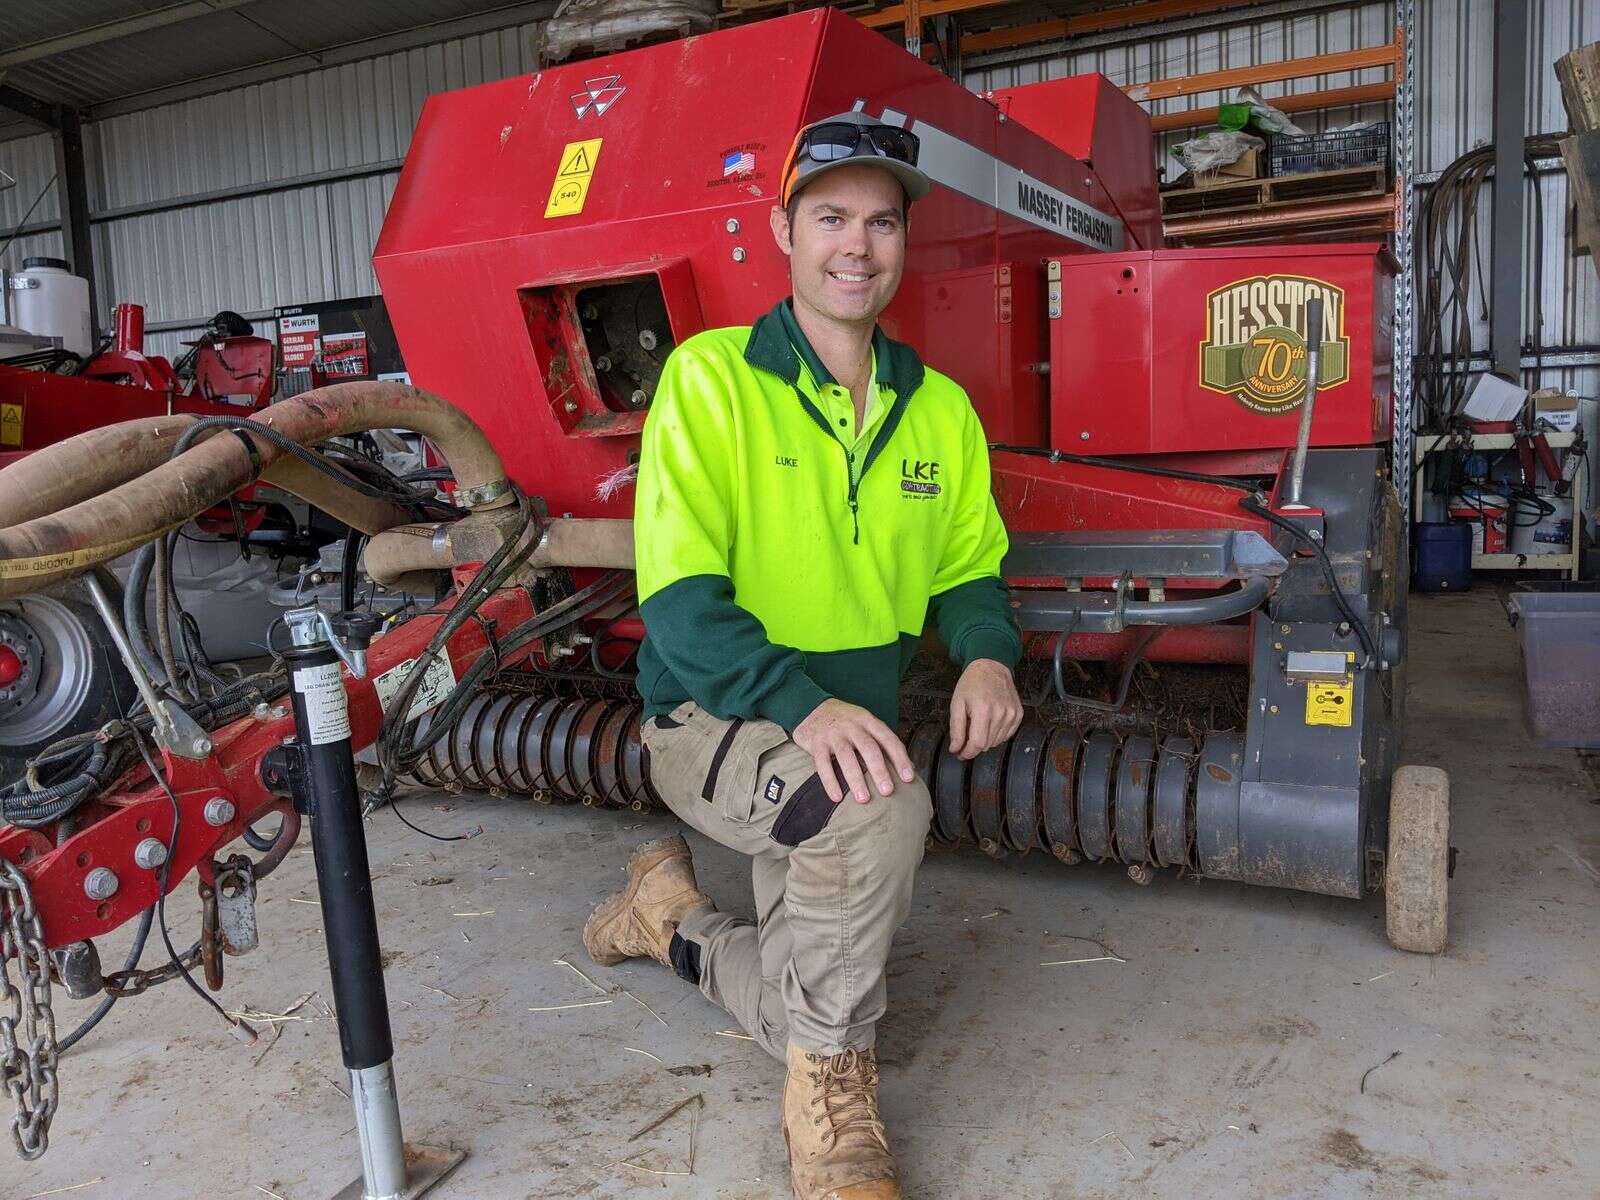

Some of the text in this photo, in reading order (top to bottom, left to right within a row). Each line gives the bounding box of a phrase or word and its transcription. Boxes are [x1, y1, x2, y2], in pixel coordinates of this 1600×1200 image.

[560, 190, 577, 199] 540
[1018, 181, 1113, 249] MASSEY FERGUSON
[1253, 338, 1305, 381] 70th
[1248, 375, 1299, 393] ANNIVERSARY
[775, 456, 798, 468] LUKE
[902, 458, 940, 480] LKF
[901, 480, 941, 494] CONTRACTING
[767, 779, 780, 800] CAT
